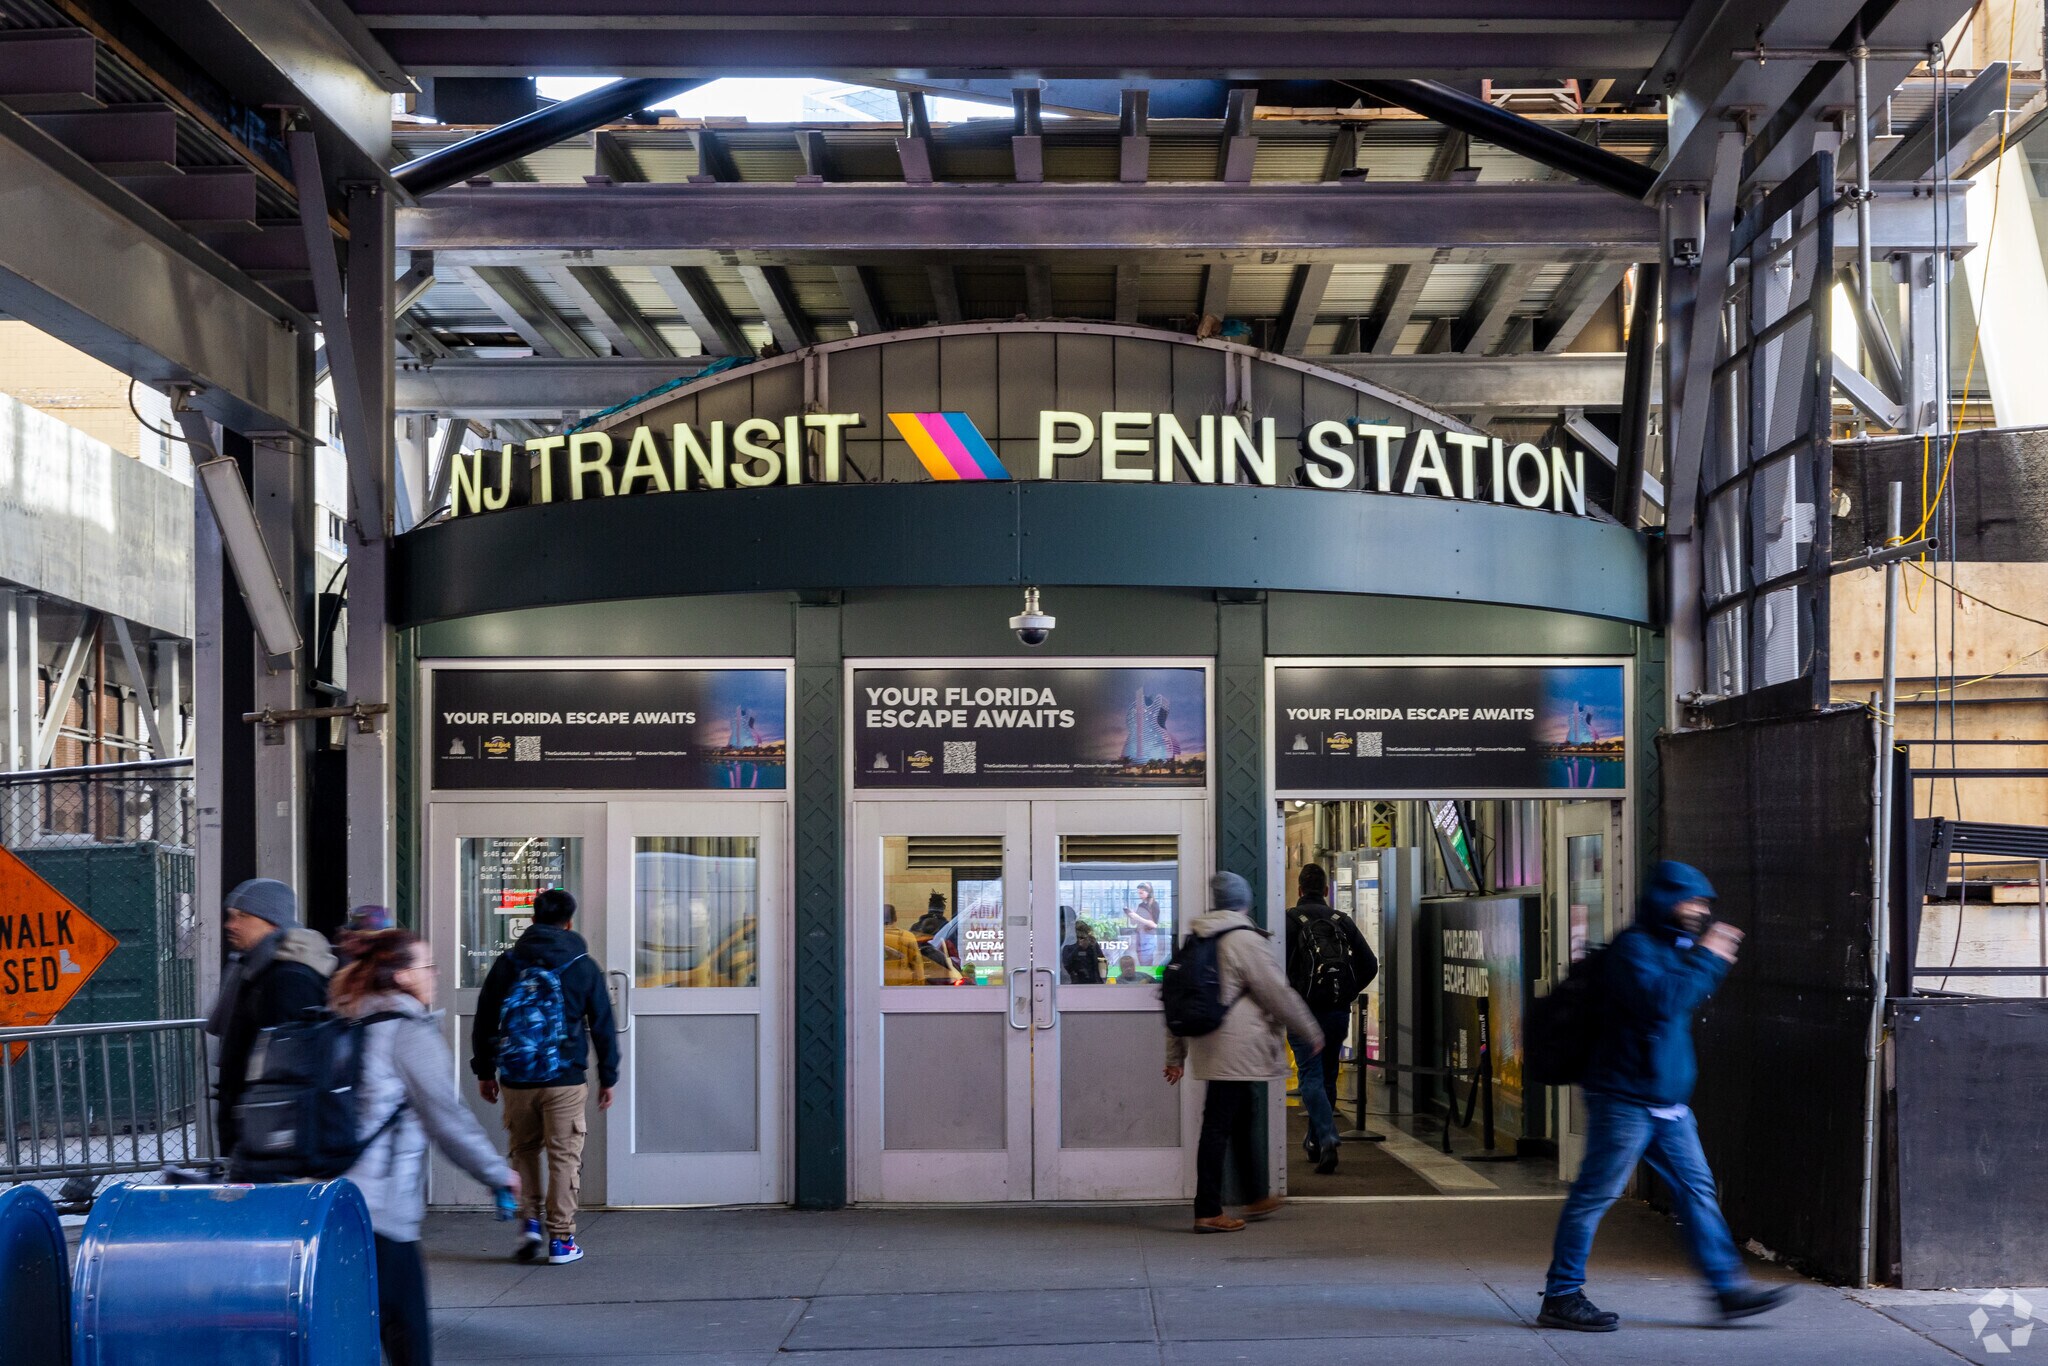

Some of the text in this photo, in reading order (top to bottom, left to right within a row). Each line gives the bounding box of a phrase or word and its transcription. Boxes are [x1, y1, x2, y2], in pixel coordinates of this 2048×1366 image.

[451, 413, 860, 517] NJ TRANSIT
[1038, 411, 1586, 515] PENN STATION
[866, 687, 1056, 706] YOUR FLORIDA
[443, 712, 696, 725] YOUR FLORIDA ESCAPE AWAITS
[866, 709, 1076, 728] ESCAPE AWAITS
[1286, 708, 1535, 720] YOUR FLORIDA ESCAPE AWAITS
[966, 930, 995, 940] OVER
[1098, 941, 1129, 950] TISTS
[966, 952, 990, 961] AND
[4, 956, 58, 995] SED
